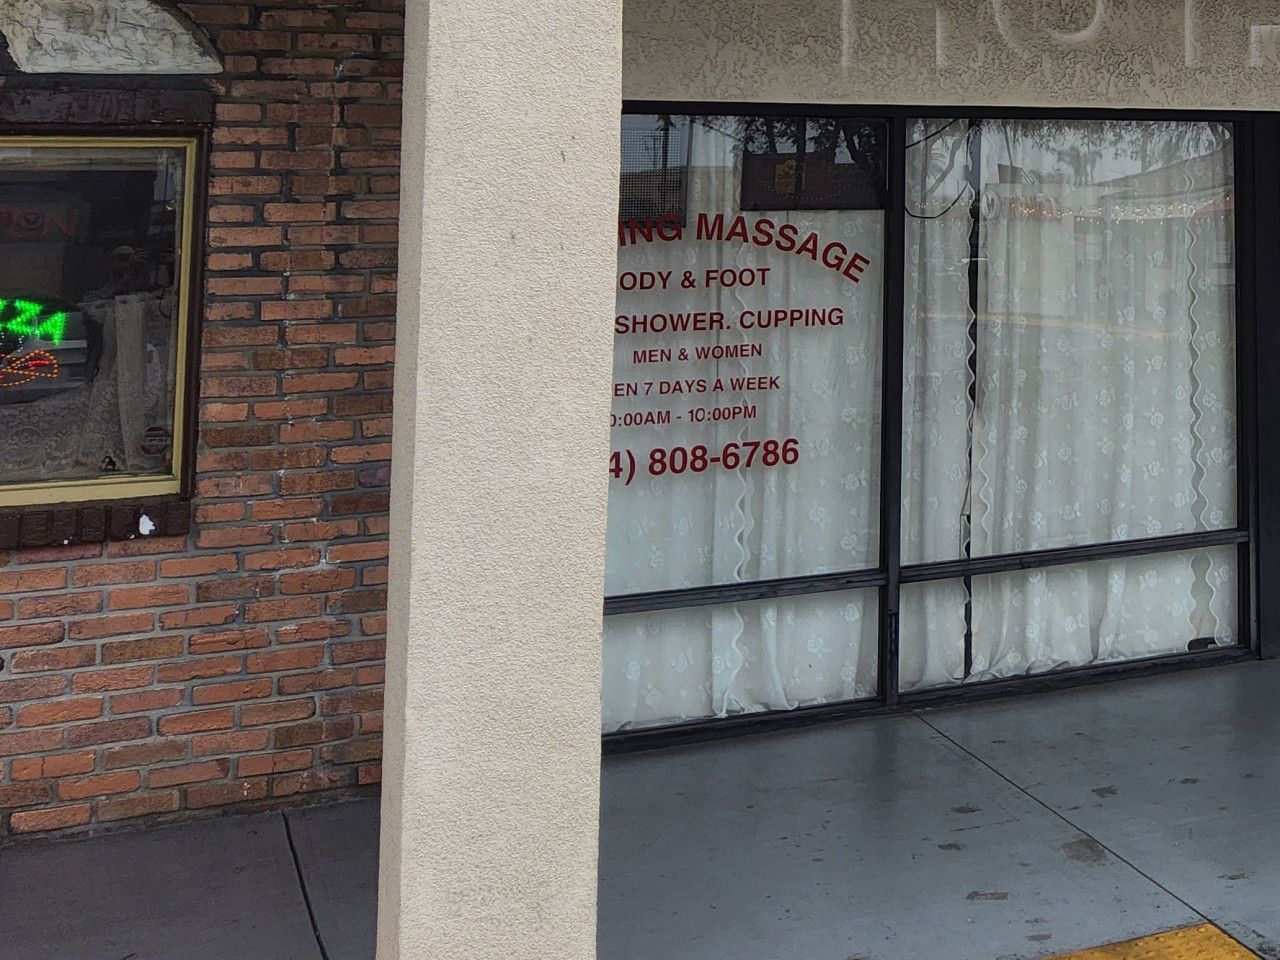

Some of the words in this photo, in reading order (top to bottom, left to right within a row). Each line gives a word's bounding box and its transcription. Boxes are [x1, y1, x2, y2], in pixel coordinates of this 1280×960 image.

[696, 213, 870, 283] MASSAGE
[680, 270, 696, 289] &
[705, 268, 771, 288] FOOT
[739, 307, 844, 329] CUPPING
[633, 349, 672, 364] MEN
[678, 348, 689, 361] &
[695, 343, 762, 360] WOMEN
[644, 382, 653, 396] 7
[660, 379, 707, 395] DAYS
[713, 378, 724, 392] A
[730, 376, 781, 391] WEEK
[688, 405, 757, 423] 10:00PM
[648, 438, 799, 476] 808-6786
